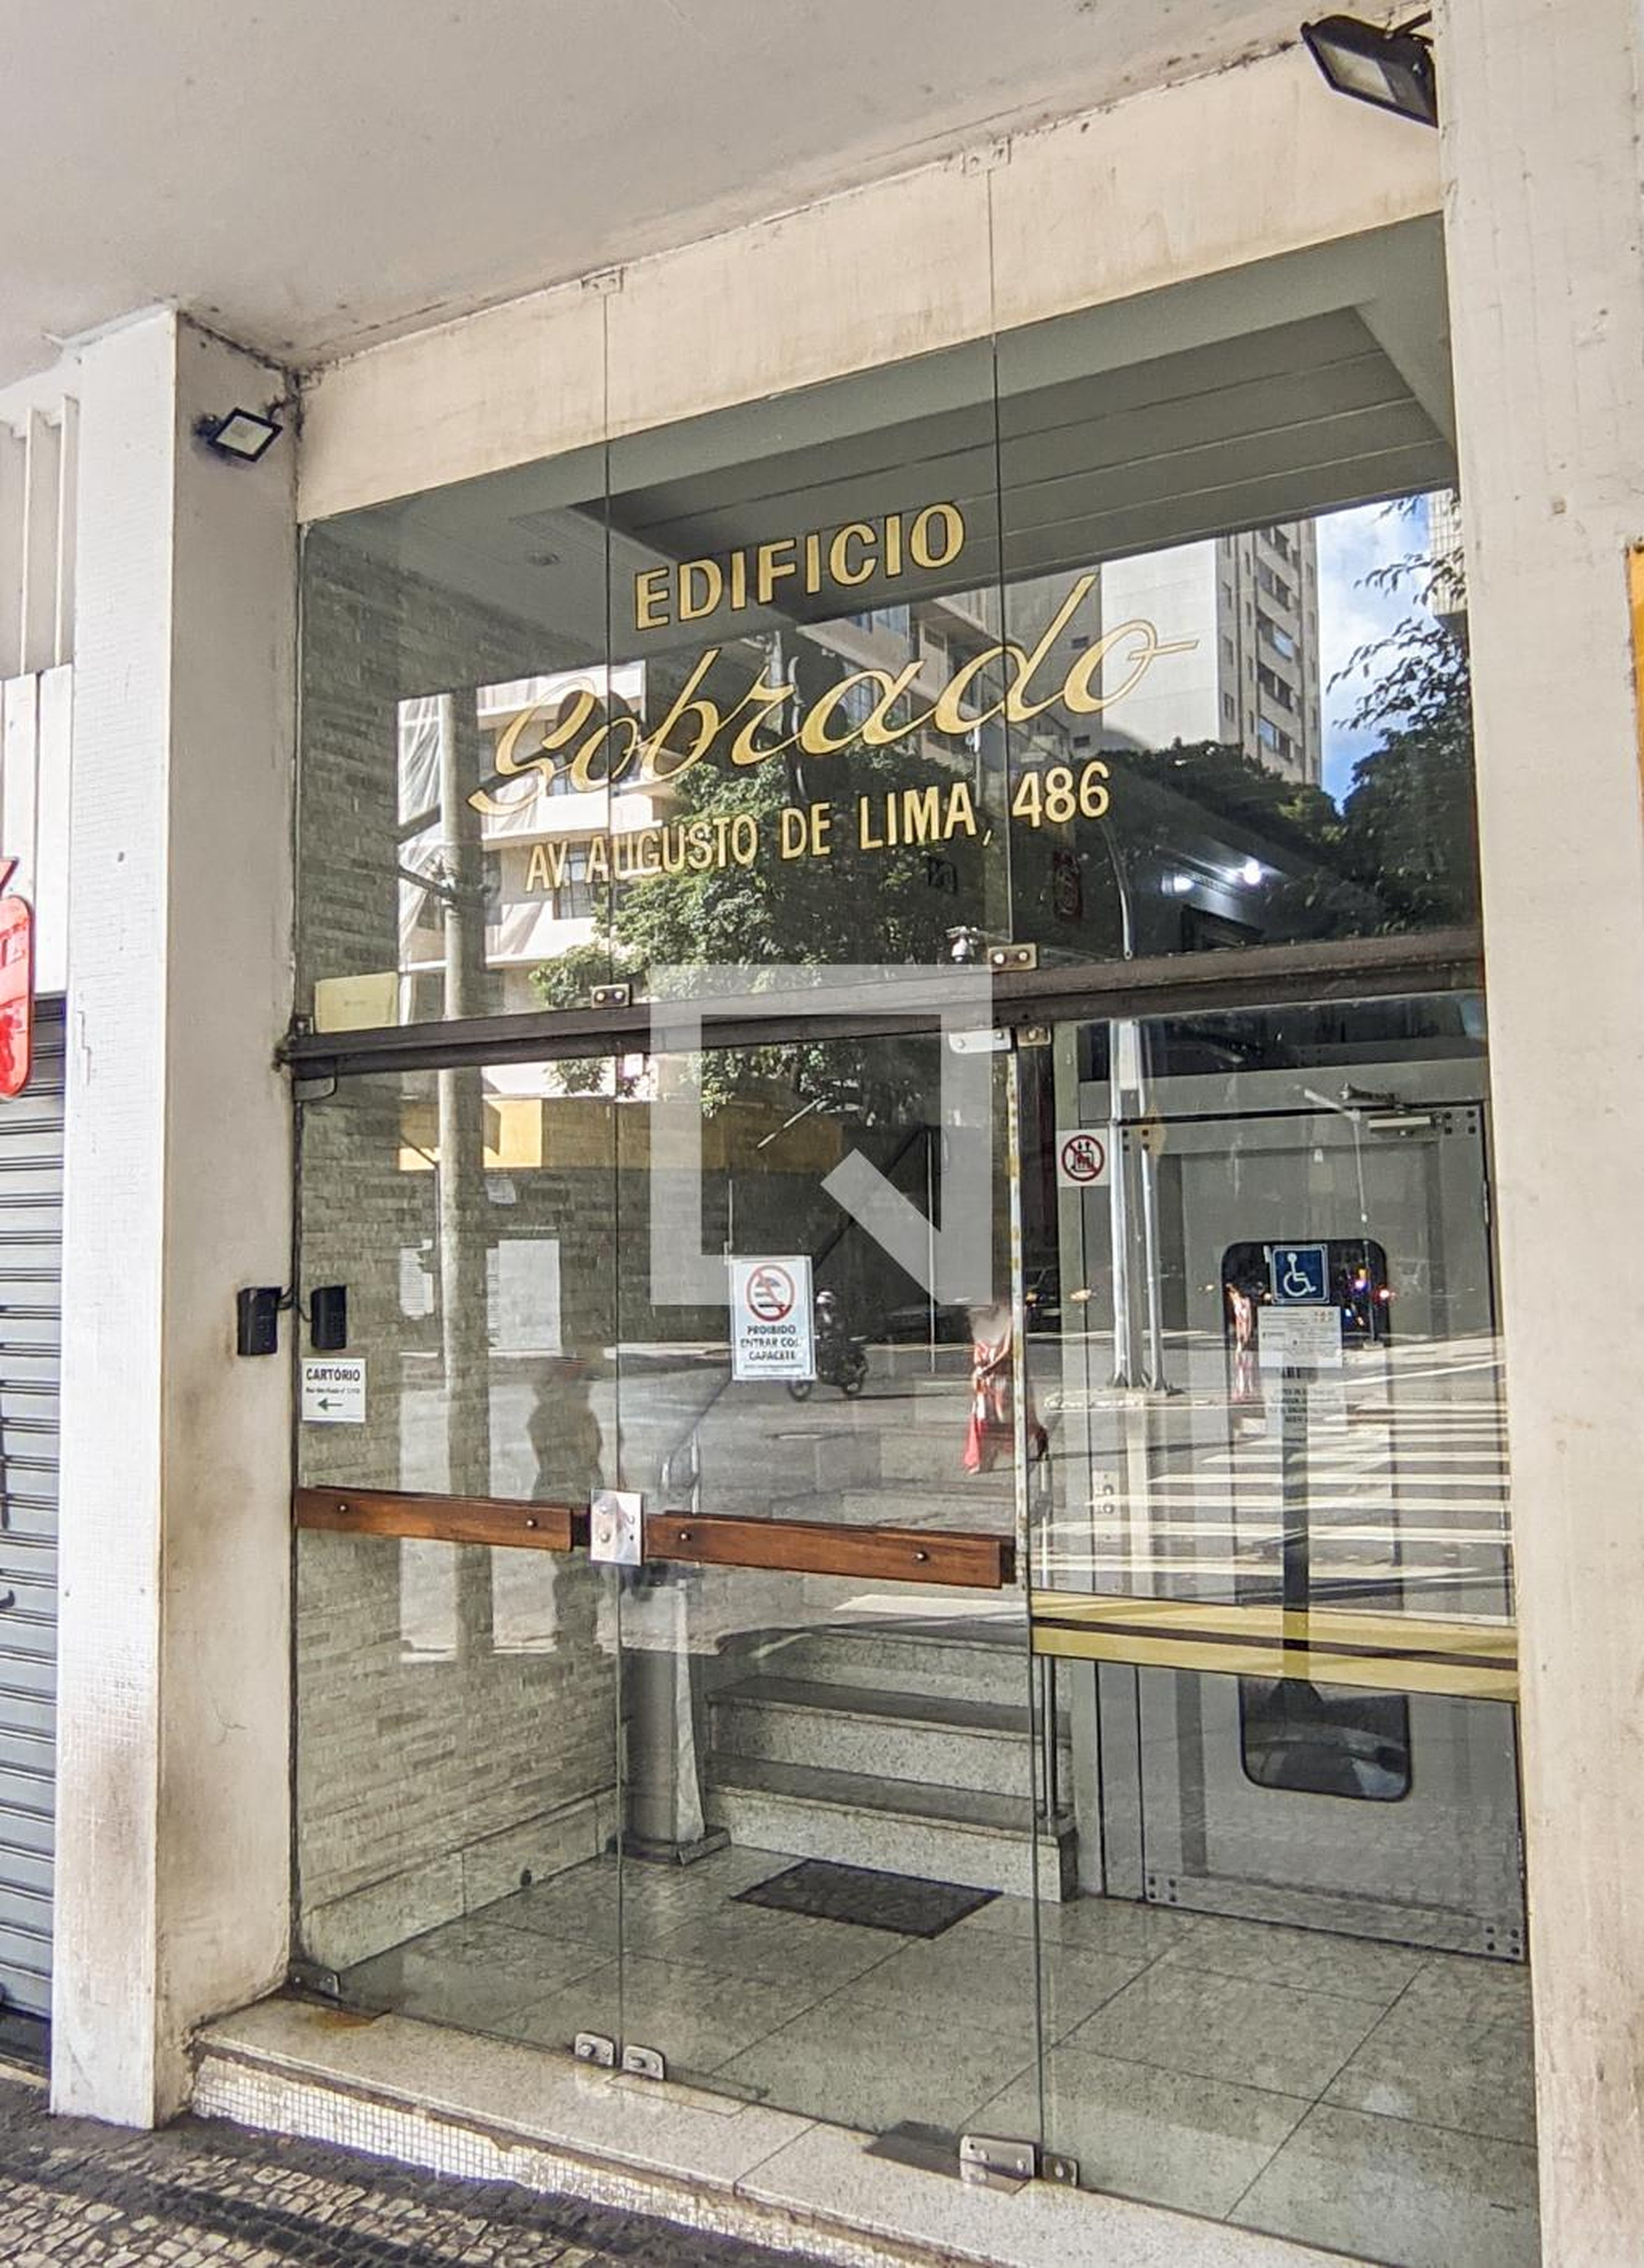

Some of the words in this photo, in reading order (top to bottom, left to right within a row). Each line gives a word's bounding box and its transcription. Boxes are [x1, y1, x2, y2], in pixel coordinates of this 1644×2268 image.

[634, 502, 965, 631] EDIFICIO
[467, 573, 1199, 815] Sobrado
[585, 814, 759, 884] AUGUSTO
[780, 801, 831, 860] DE
[859, 781, 993, 851] LIMA,
[1011, 759, 1111, 829] 486
[747, 1324, 795, 1335] PROIBIDO
[741, 1338, 777, 1348] ENTRAR
[749, 1350, 795, 1360] CAPACETE
[306, 1367, 360, 1381] CARTÓRIO
